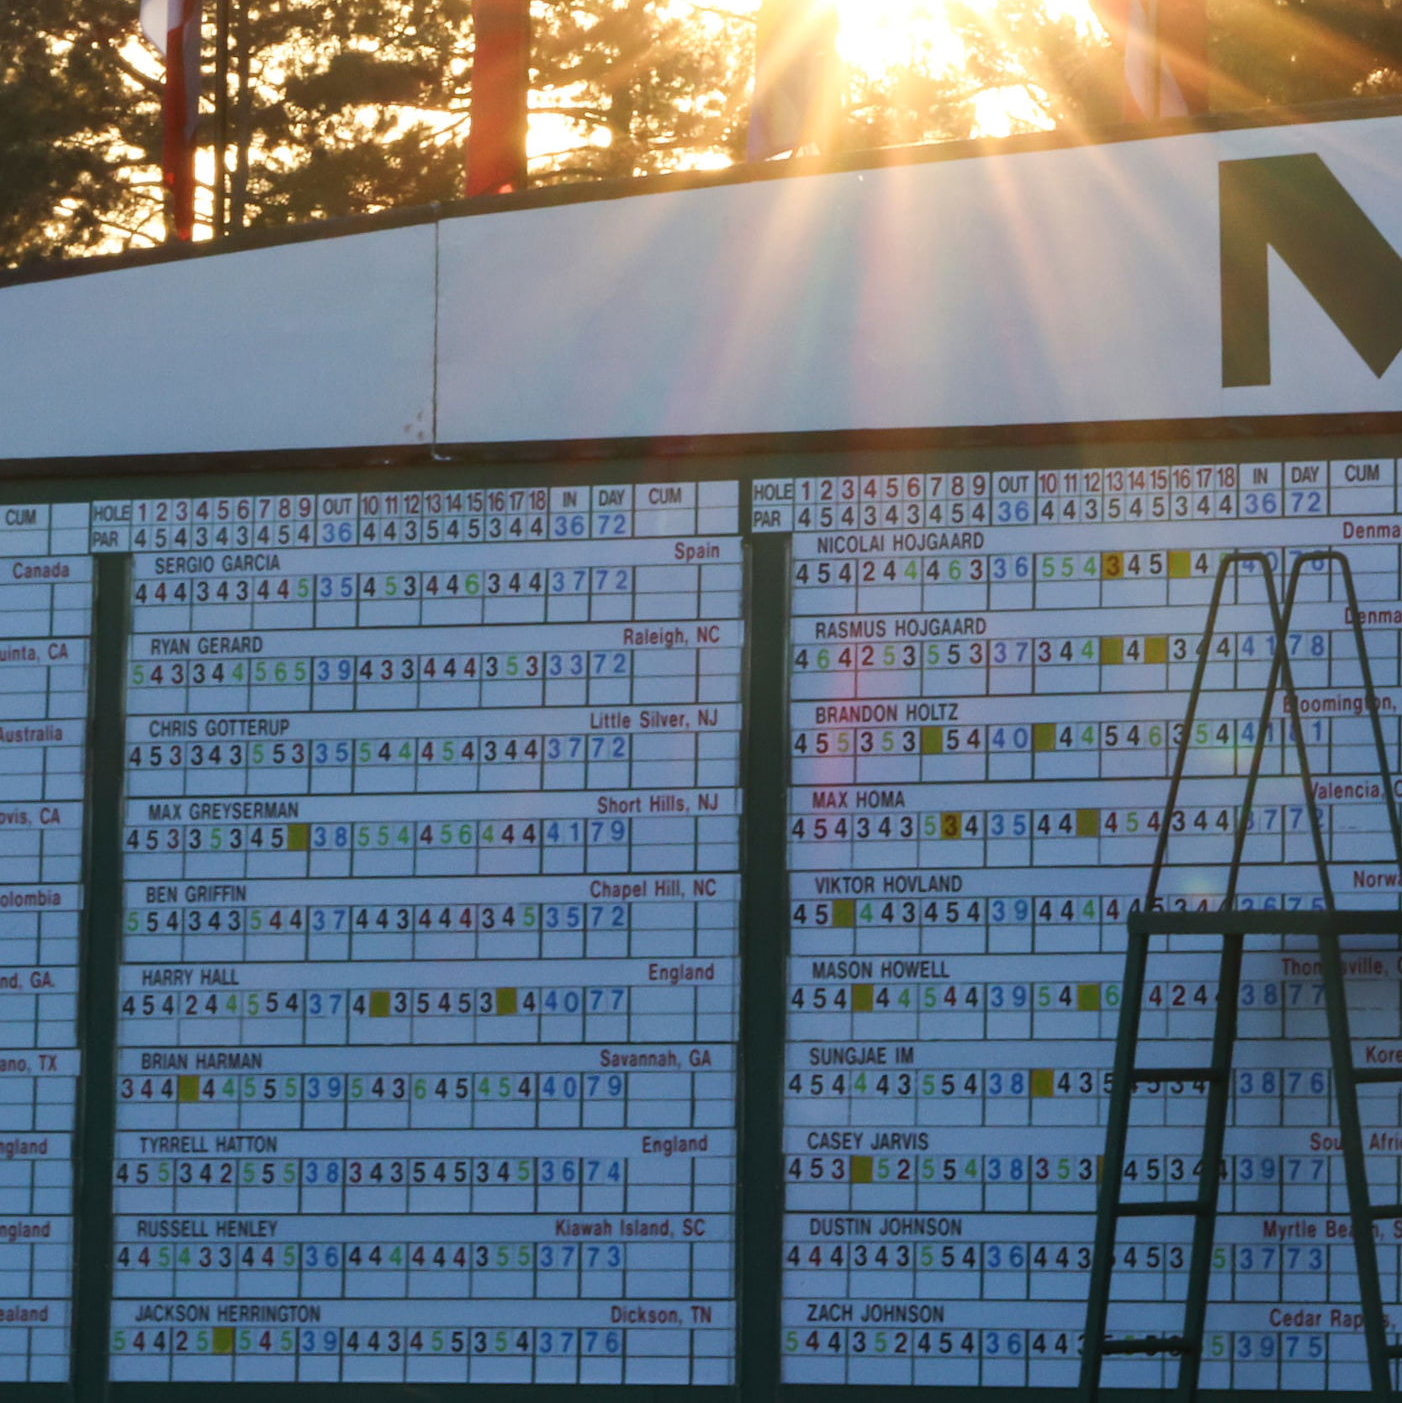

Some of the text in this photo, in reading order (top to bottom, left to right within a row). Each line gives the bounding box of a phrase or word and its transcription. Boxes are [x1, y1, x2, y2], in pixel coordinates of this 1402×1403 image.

[674, 541, 719, 562] Spain
[817, 530, 984, 554] NICOLAI HOJGAARD
[154, 553, 280, 575] SERGIO GARCIA
[815, 616, 987, 639] RASMUS HOJGAARD
[150, 635, 263, 655] RYAN GERARD
[815, 702, 958, 724] BRANDON HOLTZ
[148, 718, 290, 738] CHRIS GOTTERUP
[812, 789, 905, 808] MAX HOMA
[148, 801, 298, 820] MAX GREYSERMAN
[146, 885, 246, 903] BEN GRIFFIN
[814, 874, 962, 894] VIKTOR HOVLAND
[141, 968, 238, 986] HARRY HALL
[812, 959, 948, 980] MASON HOWELL
[141, 1051, 261, 1070] BRIAN HARMAN
[809, 1045, 914, 1066] SUNGJAE IM
[139, 1135, 276, 1154] TYRRELL HATTON
[806, 1131, 929, 1151] CASEY JARVIS
[137, 1219, 278, 1238] RUSSELL HENLEY
[809, 1216, 961, 1236] DUSTIN JOHNSON
[134, 1303, 320, 1323] JACKSON HERRINGTON
[806, 1302, 943, 1323] ZACH JOHNSON
